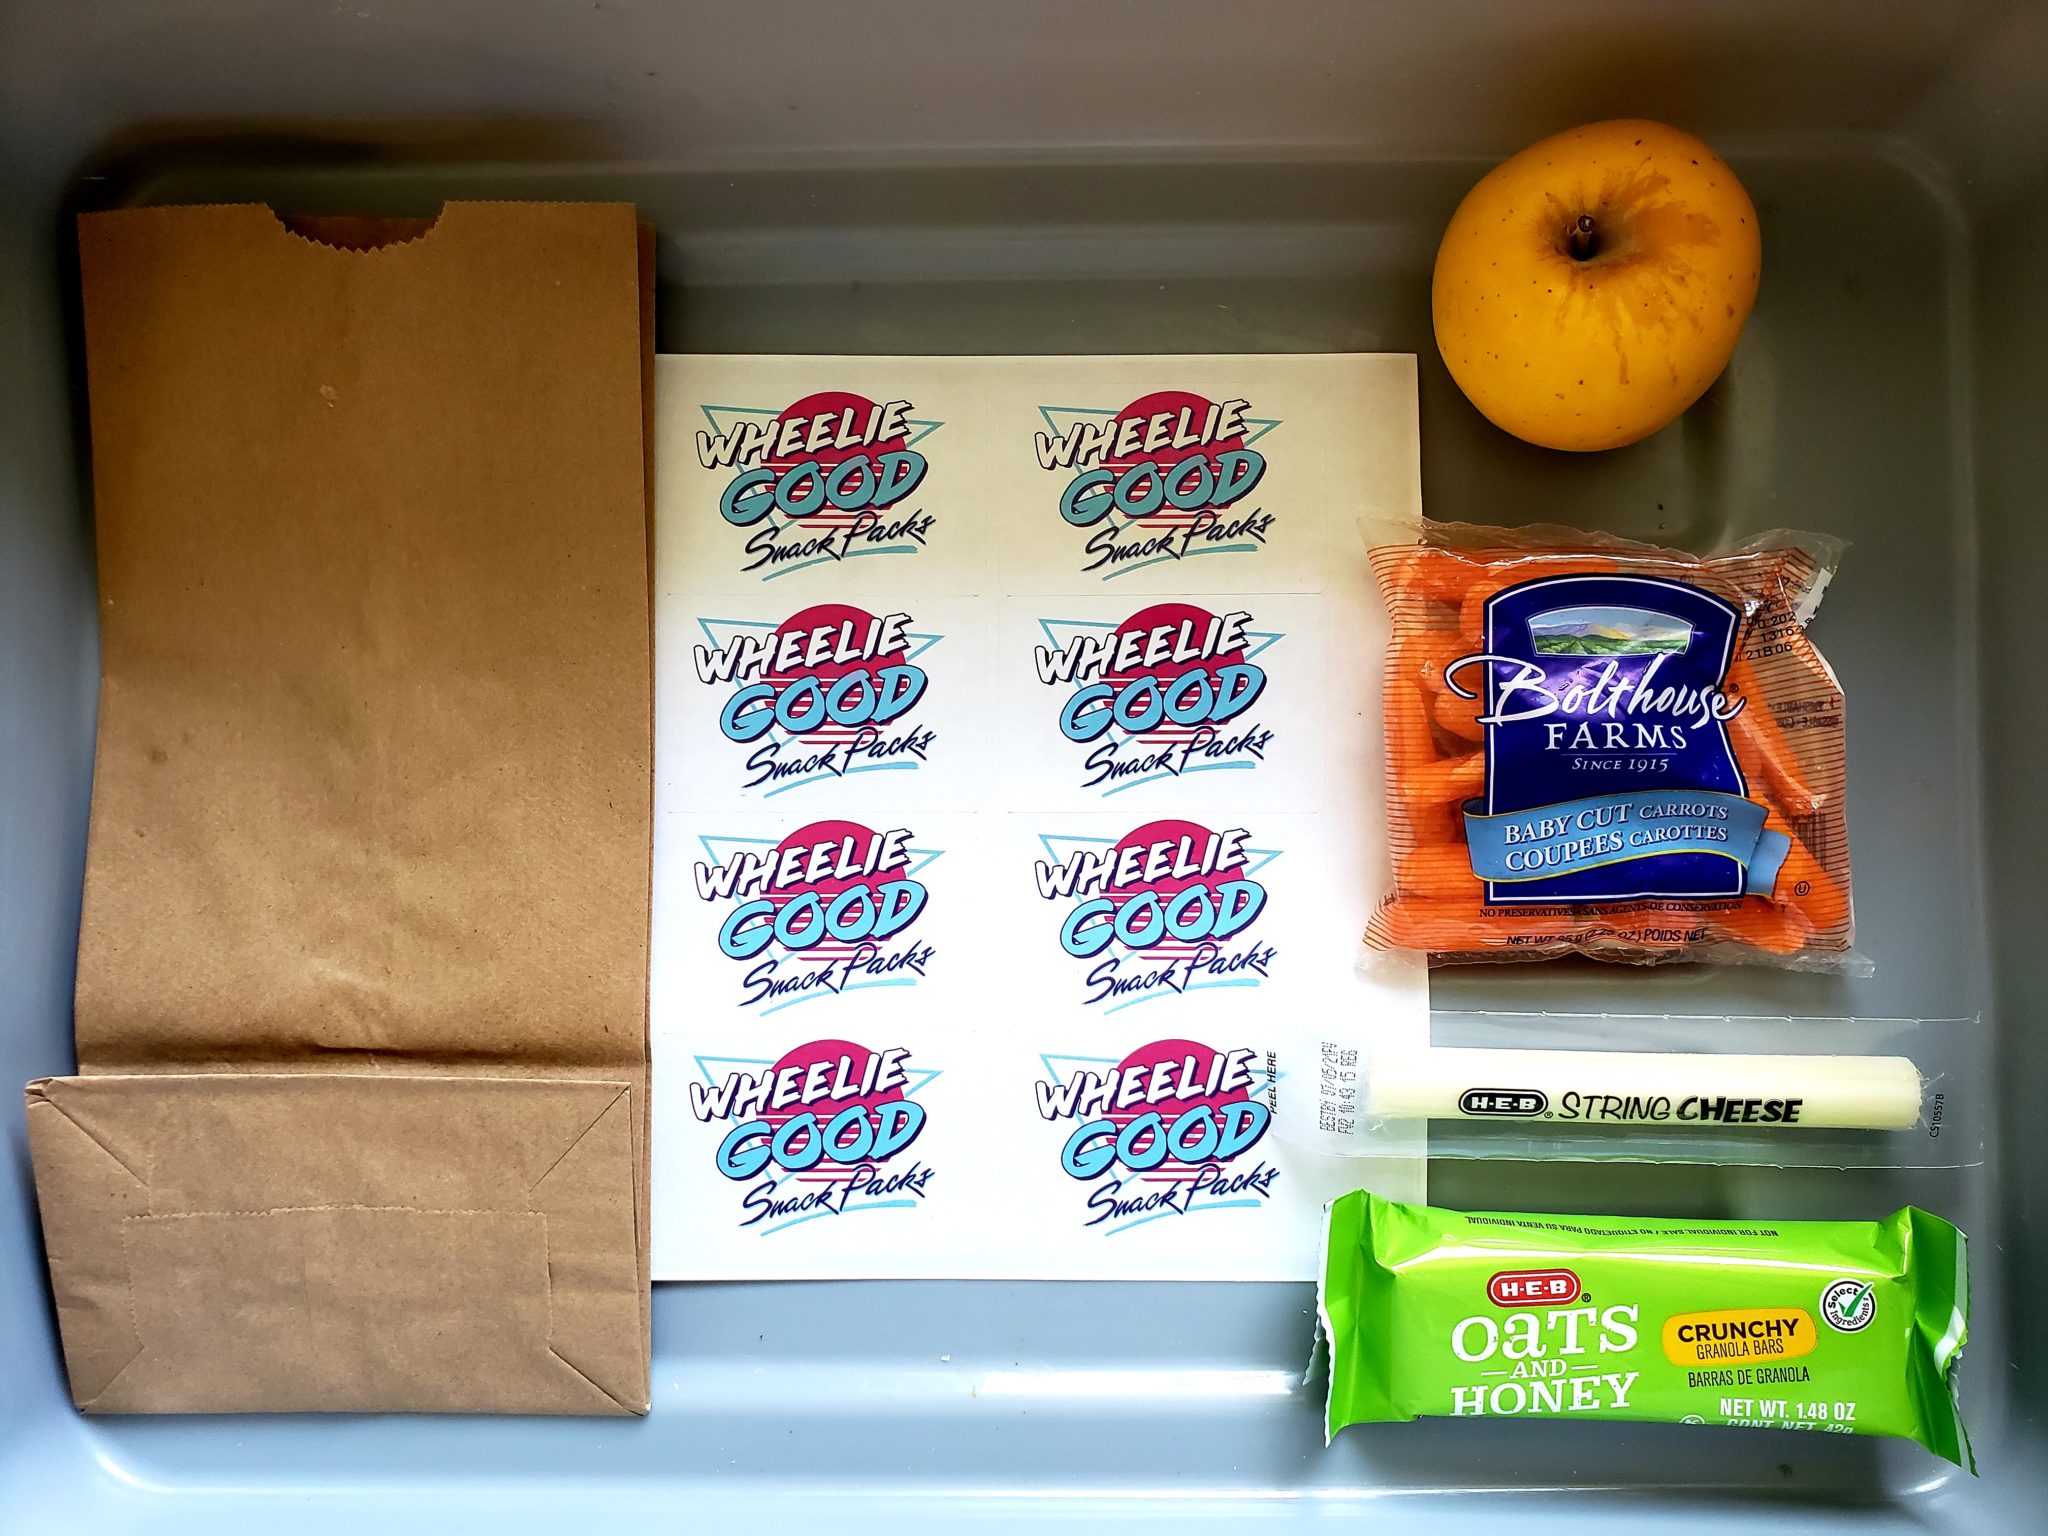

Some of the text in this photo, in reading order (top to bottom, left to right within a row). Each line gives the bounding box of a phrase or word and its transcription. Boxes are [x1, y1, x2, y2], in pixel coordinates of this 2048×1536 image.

[696, 399, 915, 469] WHEELIE
[1036, 398, 1253, 470] WHEELIE
[720, 450, 928, 527] GOOD
[1060, 450, 1267, 527] GOOD
[741, 509, 935, 572] Snack Packs
[1081, 508, 1275, 572] Snack Packs
[694, 611, 915, 684] WHEELIE
[1036, 610, 1253, 684] WHEELIE
[720, 664, 928, 743] GOOD
[1060, 664, 1267, 743] GOOD
[1444, 652, 1747, 729] Bolthouse
[742, 723, 935, 788] Snack Packs
[1081, 723, 1274, 788] Snack Packs
[1543, 722, 1688, 750] FARMS
[1572, 757, 1670, 773] SINCE 1915
[1504, 803, 1729, 846] BABY CUT CARROTS
[1505, 824, 1729, 872] COUPEES CAROTTES
[694, 828, 915, 901] WHEELIE
[1034, 828, 1253, 899] WHEELIE
[718, 880, 928, 960] GOOD
[1060, 880, 1268, 959] GOOD
[1479, 901, 1742, 918] NO PRESERVATIVES SANS AGENTS DE CONSERVATION
[1643, 929, 1681, 941] POIDS
[1684, 928, 1709, 941] NET
[738, 940, 935, 1006] Snack Packs
[1082, 940, 1277, 1005] Snack Packs
[689, 1048, 913, 1120] WHEELIE
[1036, 1047, 1253, 1121] WHEELIE
[1266, 1049, 1277, 1113] PEEL HERE
[1558, 1091, 1803, 1123] STRING CHEESE
[716, 1100, 927, 1180] GOOD
[1060, 1100, 1271, 1179] GOOD
[1929, 1092, 1944, 1137] CS10557B
[739, 1162, 935, 1226] Snack Packs
[1085, 1161, 1279, 1226] Snack Packs
[1463, 1215, 1514, 1227] INDIVIDUAL
[1515, 1219, 1543, 1230] VENTA
[1544, 1222, 1556, 1231] SU
[1557, 1223, 1582, 1233] PARA
[1583, 1227, 1637, 1235] ETIQUETADO
[1684, 1228, 1737, 1236] INDIVIDUAL
[1738, 1228, 1756, 1236] FOR
[1759, 1228, 1778, 1236] NOT
[1828, 1287, 1859, 1308] Select
[1830, 1300, 1870, 1327] Ingredients
[1678, 1318, 1799, 1343] CRUNCHY
[1696, 1338, 1784, 1360] GRANOLA BARS
[1450, 1372, 1639, 1416] HONEY
[1510, 1359, 1567, 1379] AND
[1688, 1366, 1810, 1388] BARRAS DE GRANOLA
[1720, 1398, 1856, 1421] NET WT. 1.48 OZ
